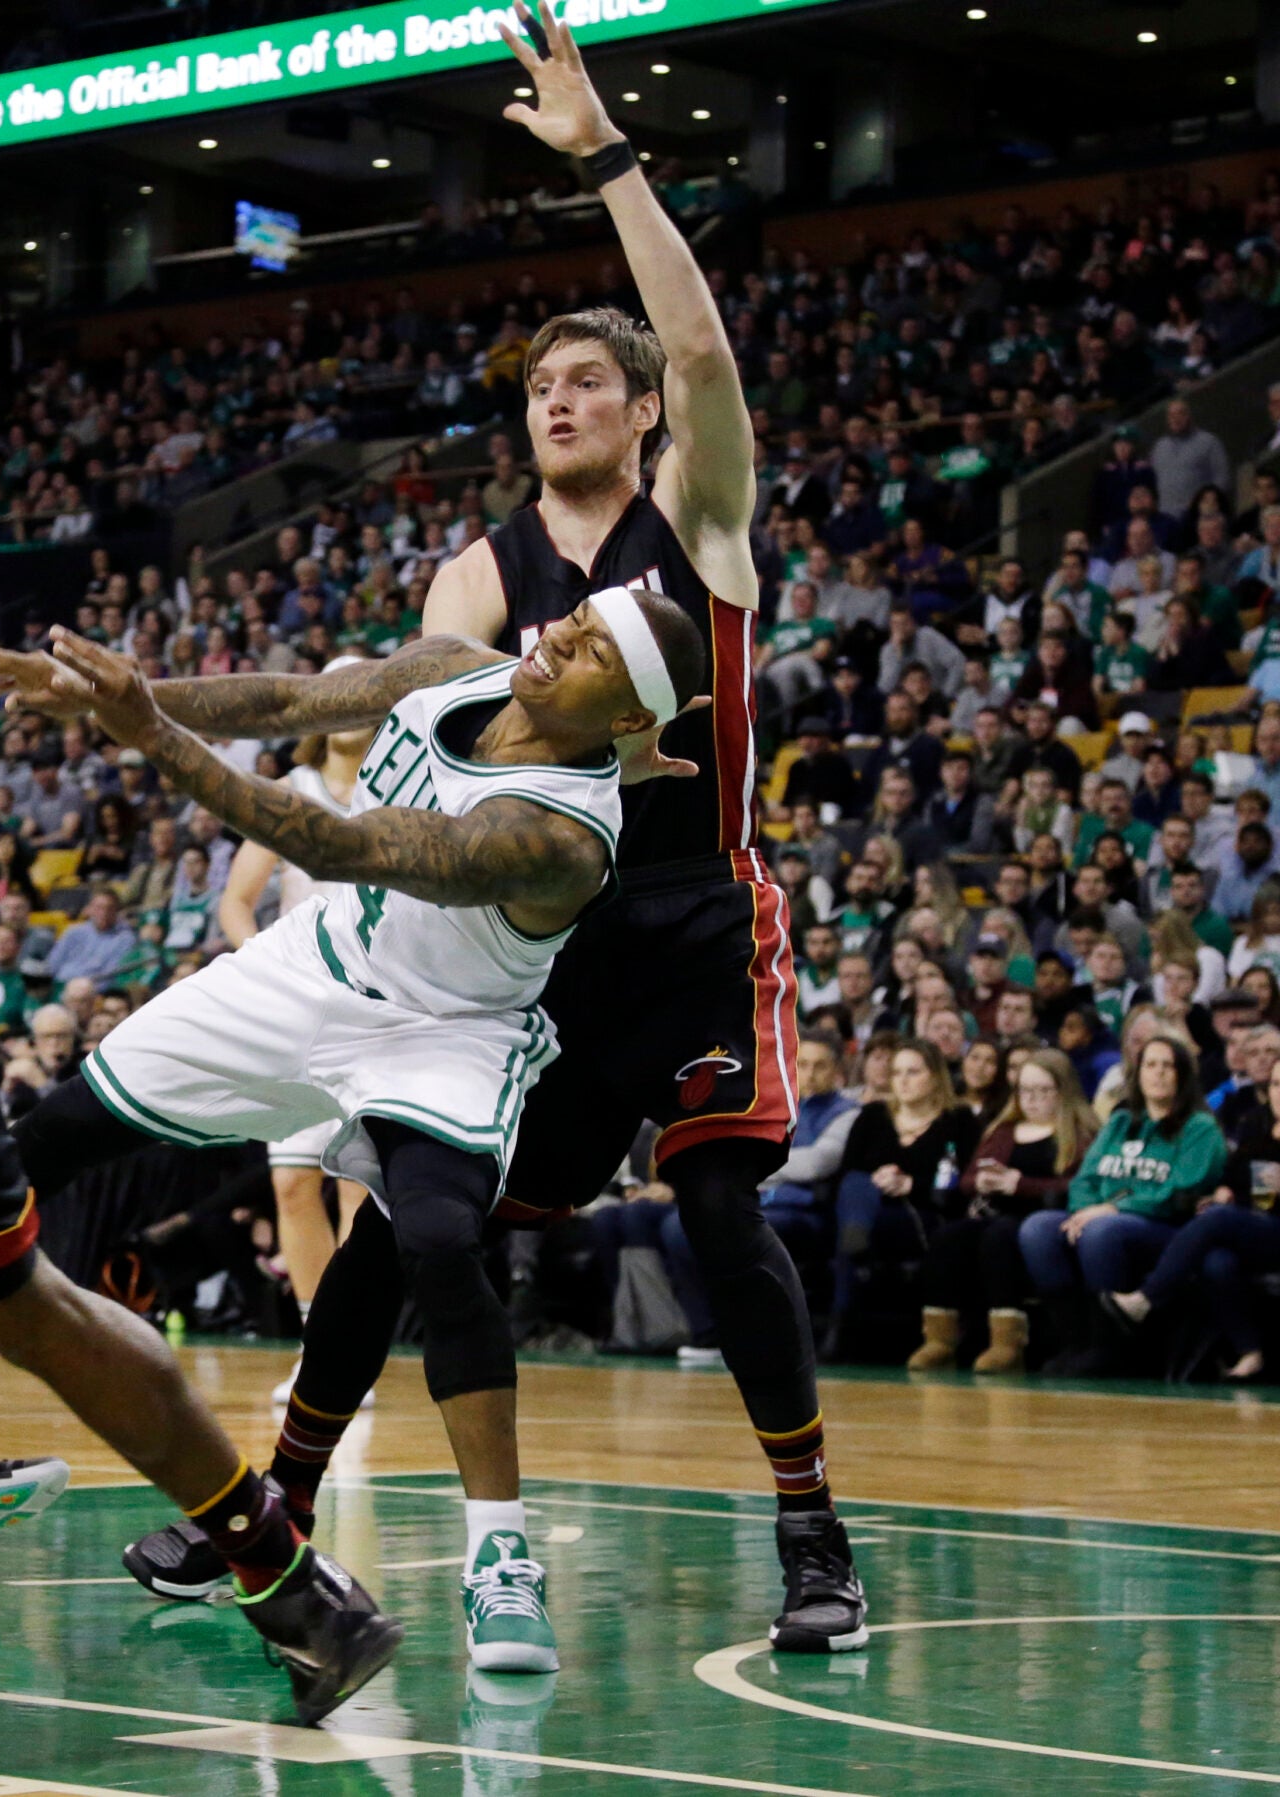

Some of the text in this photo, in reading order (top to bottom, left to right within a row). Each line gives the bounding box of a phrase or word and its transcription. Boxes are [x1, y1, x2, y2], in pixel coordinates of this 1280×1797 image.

[7, 84, 64, 126] the
[69, 57, 189, 114] Official
[196, 40, 282, 93] Bank
[287, 30, 330, 77] of
[334, 24, 398, 70] the
